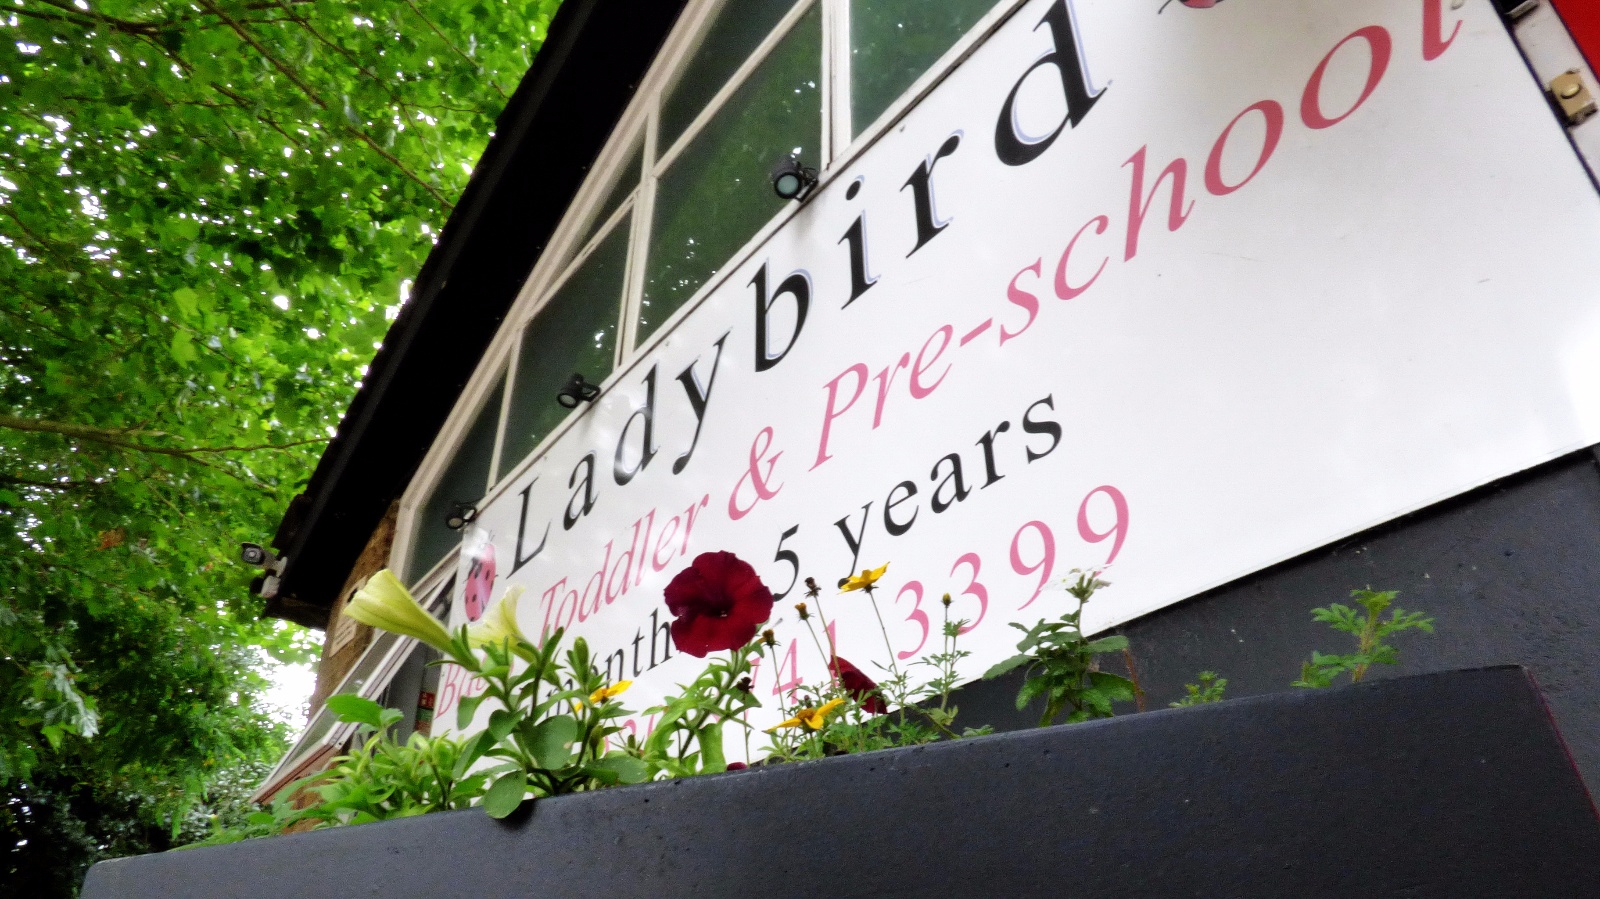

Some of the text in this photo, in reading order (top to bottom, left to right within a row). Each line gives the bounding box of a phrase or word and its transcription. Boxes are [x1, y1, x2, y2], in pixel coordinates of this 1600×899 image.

[506, 0, 1112, 579] Ladybird
[539, 493, 709, 650] Toddler
[727, 426, 784, 521] &
[543, 393, 1062, 724] mnth 5 years
[895, 485, 1129, 660] 3399
